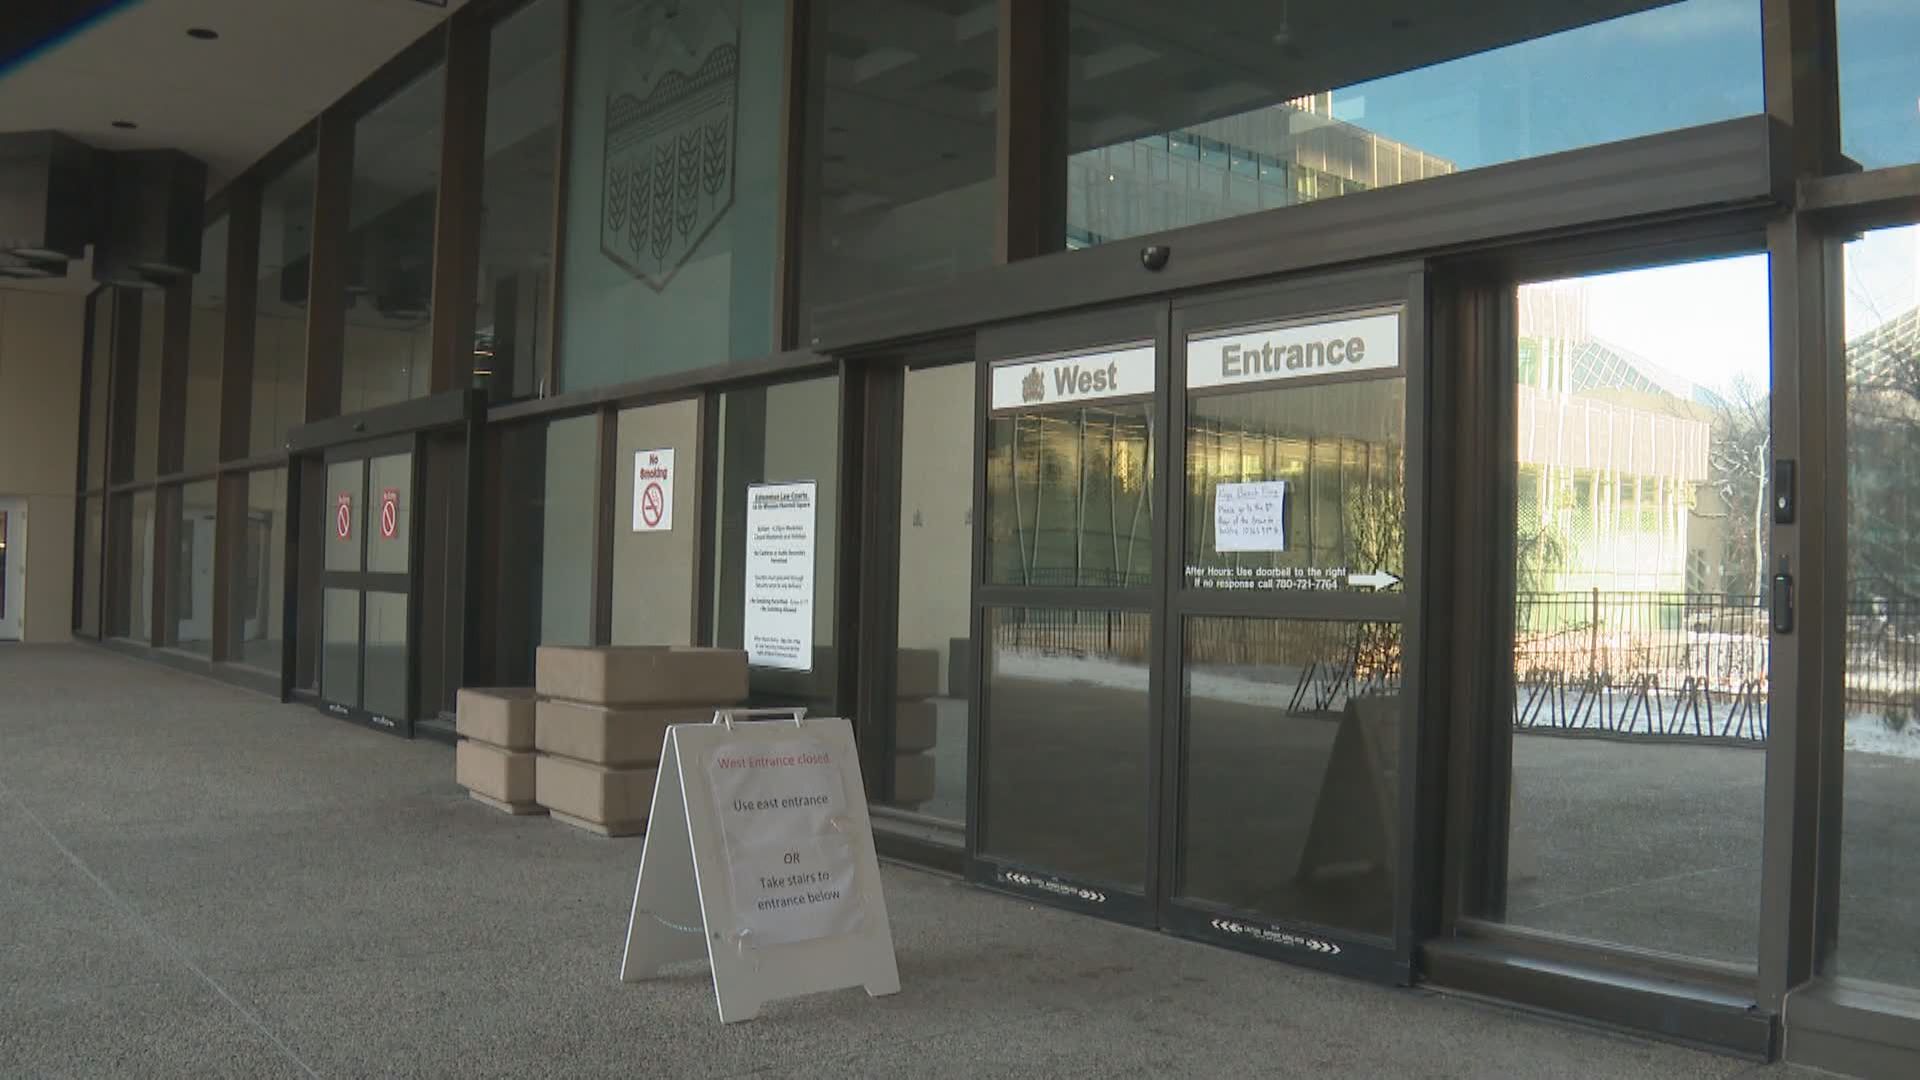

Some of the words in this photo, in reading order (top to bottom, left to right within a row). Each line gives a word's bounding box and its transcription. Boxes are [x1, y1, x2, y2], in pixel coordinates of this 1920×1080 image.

[1054, 359, 1118, 396] West
[1221, 335, 1366, 378] Entrance
[649, 454, 659, 465] No
[640, 467, 667, 480] Smoking
[1185, 566, 1205, 577] After
[1208, 566, 1234, 577] Hours:
[1237, 567, 1253, 577] Use
[1256, 566, 1291, 577] doorbell
[1294, 566, 1303, 577] to
[1308, 566, 1322, 577] the
[1325, 566, 1346, 579] right
[1194, 577, 1201, 588] If
[1203, 580, 1213, 588] no
[1216, 579, 1254, 591] response
[1258, 578, 1273, 589] call
[1275, 578, 1338, 590] 780-721-7764
[717, 757, 746, 770] West
[750, 755, 795, 769] Entrance
[733, 800, 754, 813] Use
[757, 798, 779, 810] east
[782, 794, 829, 809] entrance
[783, 852, 801, 865] OR
[760, 875, 785, 889] Take
[788, 872, 816, 885] stairs
[818, 871, 830, 882] to
[757, 894, 806, 911] entrance
[807, 889, 841, 904] below
